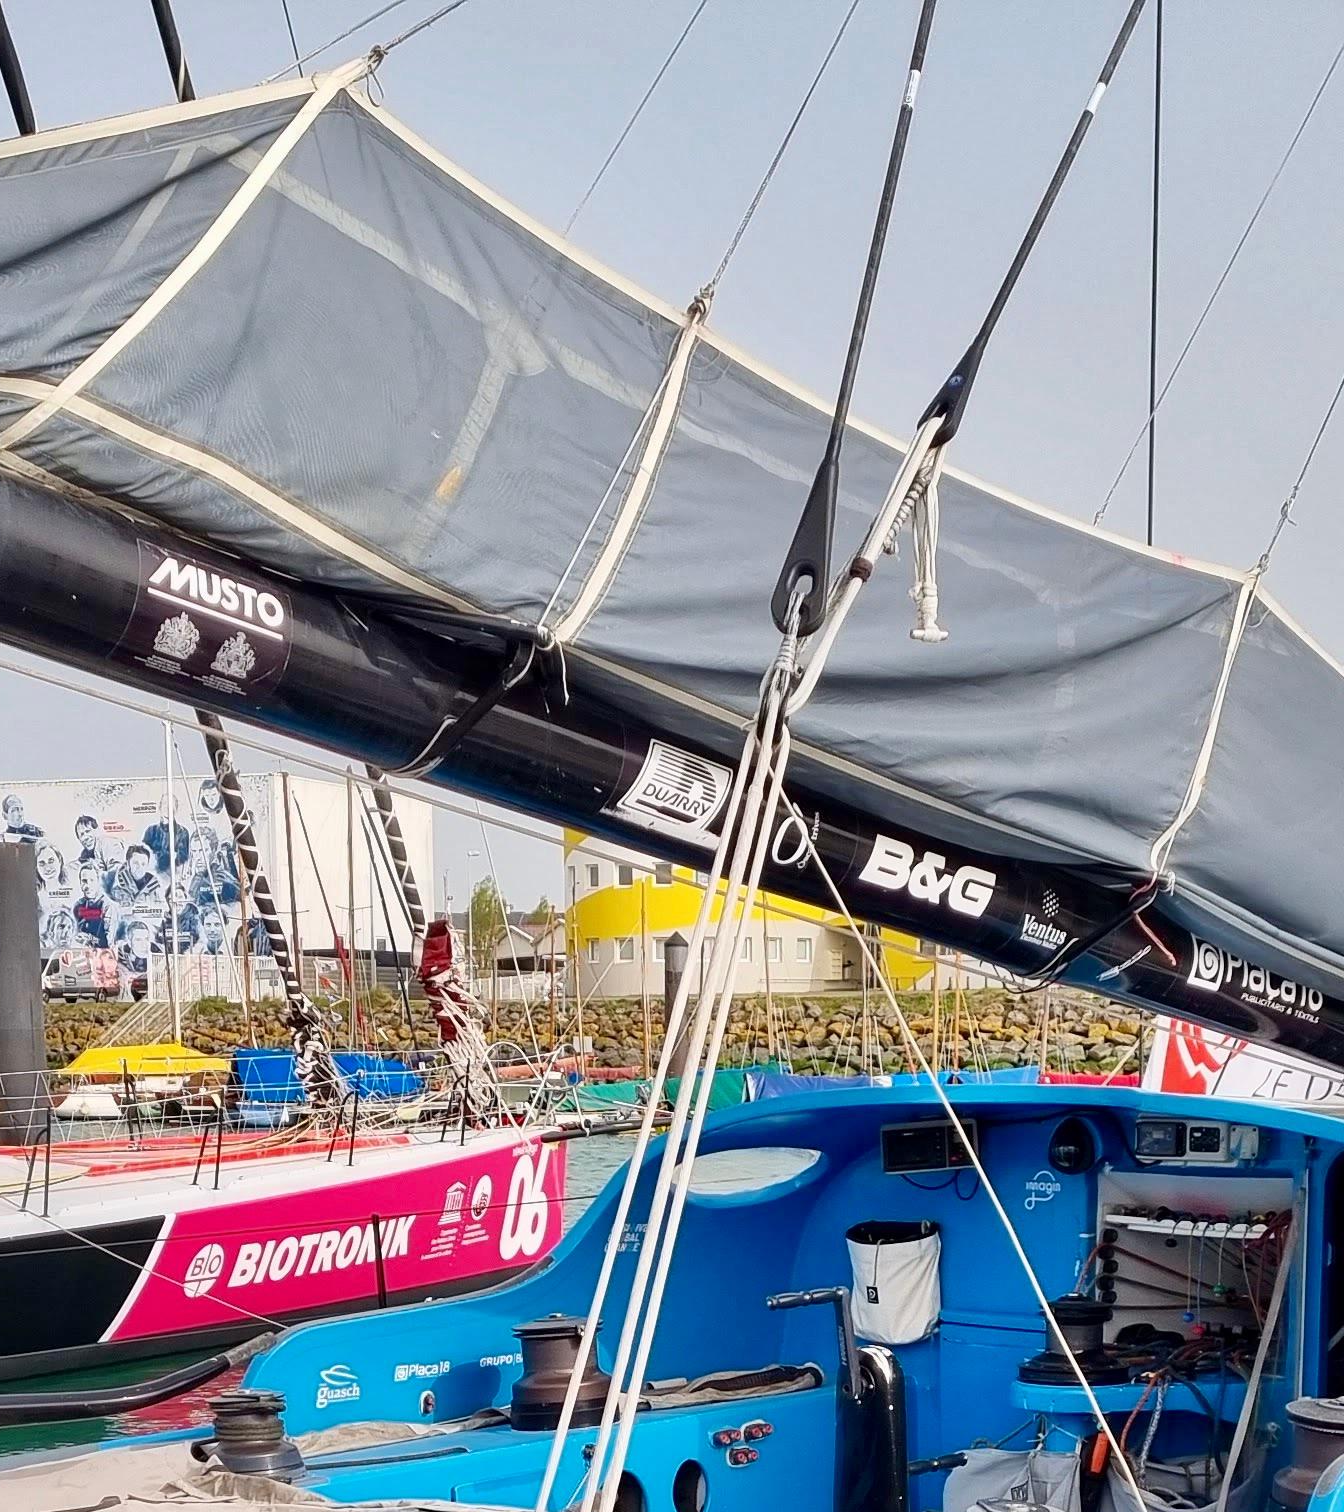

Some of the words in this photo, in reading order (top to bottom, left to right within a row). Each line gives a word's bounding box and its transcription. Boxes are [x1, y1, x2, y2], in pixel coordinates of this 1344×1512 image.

[149, 557, 285, 627] MUSTO
[642, 783, 712, 816] DUARRY
[858, 833, 997, 919] B&G
[1022, 914, 1067, 946] Ventus
[499, 1143, 549, 1261] 06
[190, 1252, 222, 1279] BIO
[227, 1214, 418, 1288] BIOTRONIK
[479, 1354, 513, 1368] GRUPO
[316, 1383, 360, 1408] guasch
